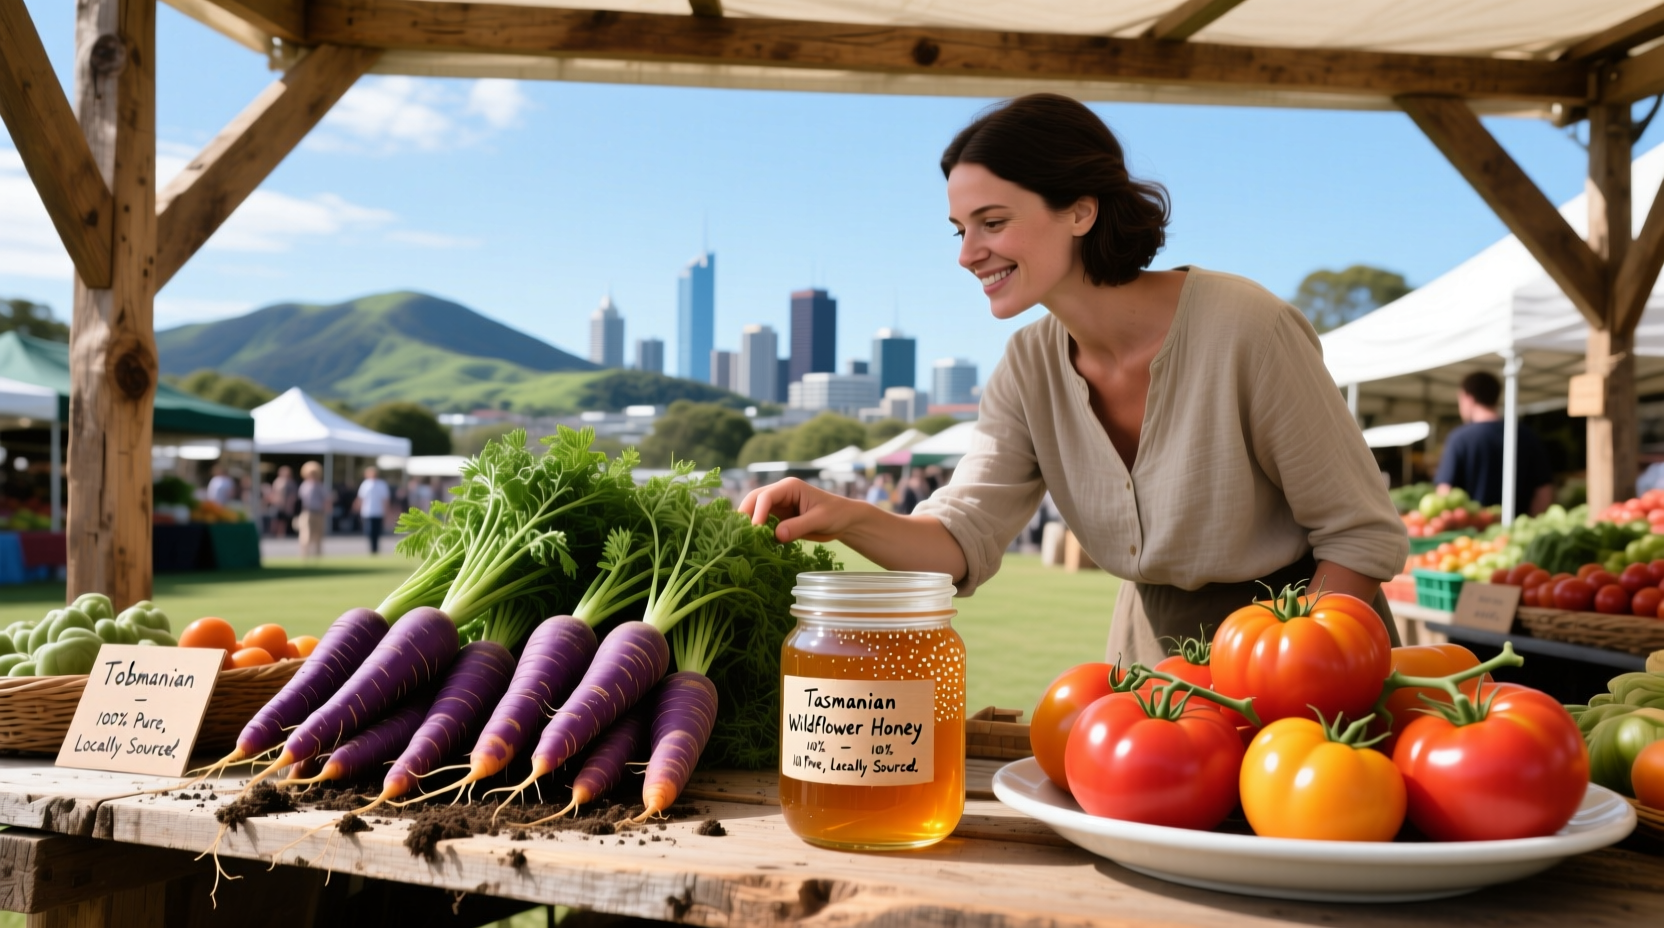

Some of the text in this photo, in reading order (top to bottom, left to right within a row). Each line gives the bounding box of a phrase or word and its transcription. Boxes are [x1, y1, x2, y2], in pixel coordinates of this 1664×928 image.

[804, 688, 896, 710] Tasmanian
[96, 711, 166, 734] 100% Pure,
[789, 713, 922, 745] Wildflower Honey
[74, 734, 122, 760] Locally
